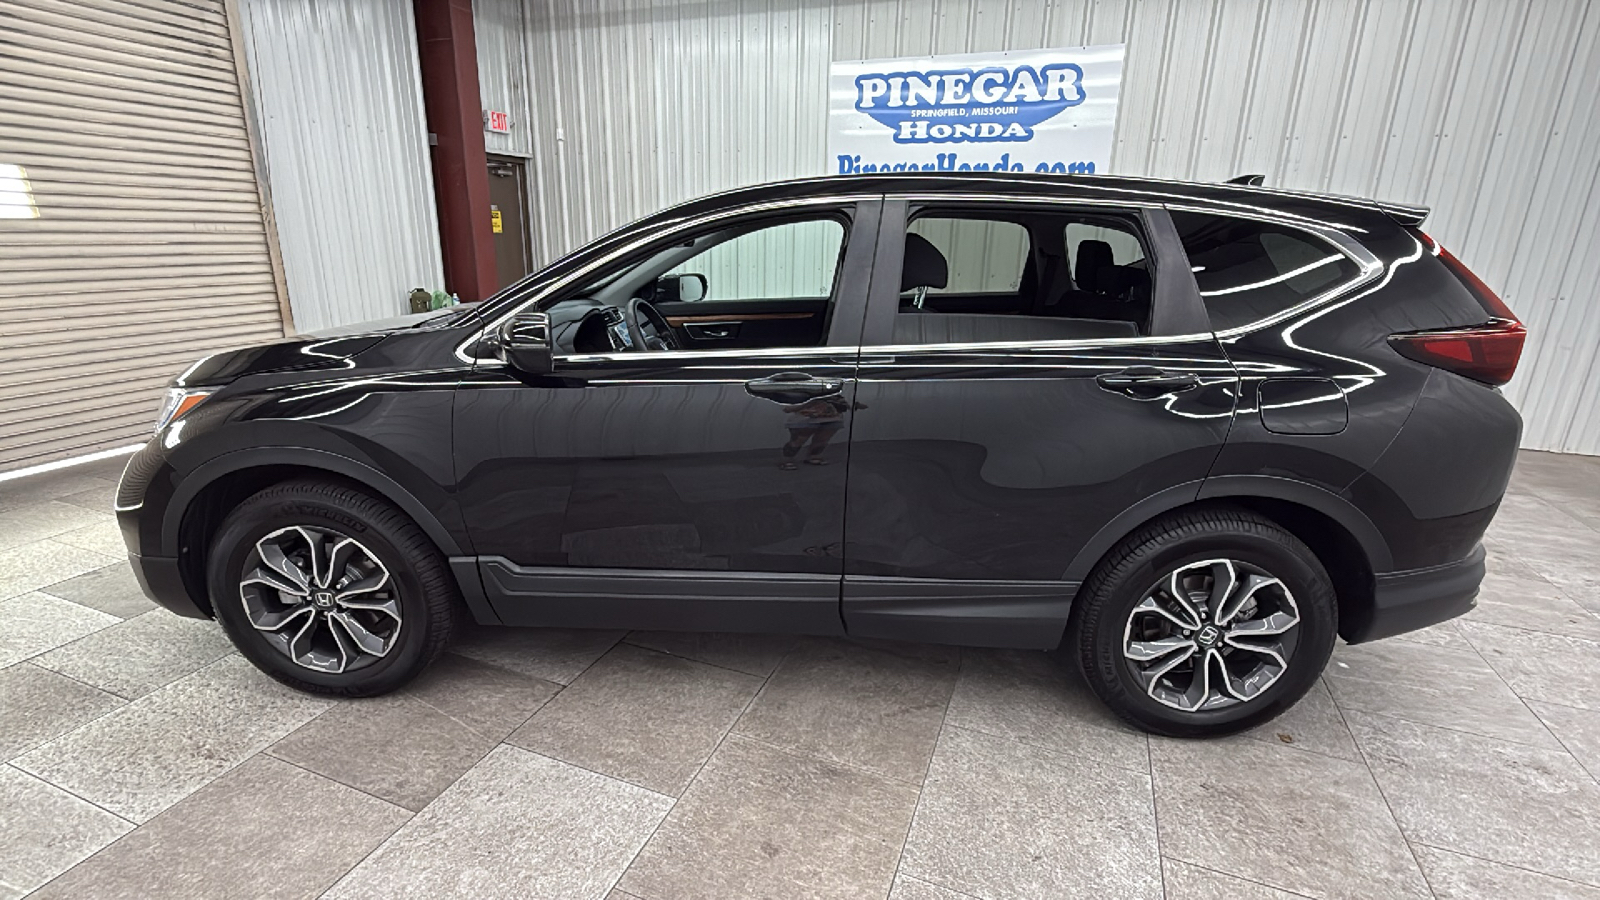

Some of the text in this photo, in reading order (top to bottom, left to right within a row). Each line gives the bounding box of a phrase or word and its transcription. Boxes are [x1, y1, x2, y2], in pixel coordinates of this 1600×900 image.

[859, 68, 1081, 108] PINEGAR
[491, 111, 507, 132] EXIT
[911, 106, 1019, 118] SPRINGFIELD, MISSOURI
[898, 121, 1029, 139] HONDA
[837, 153, 1096, 175] PinrHndcom
